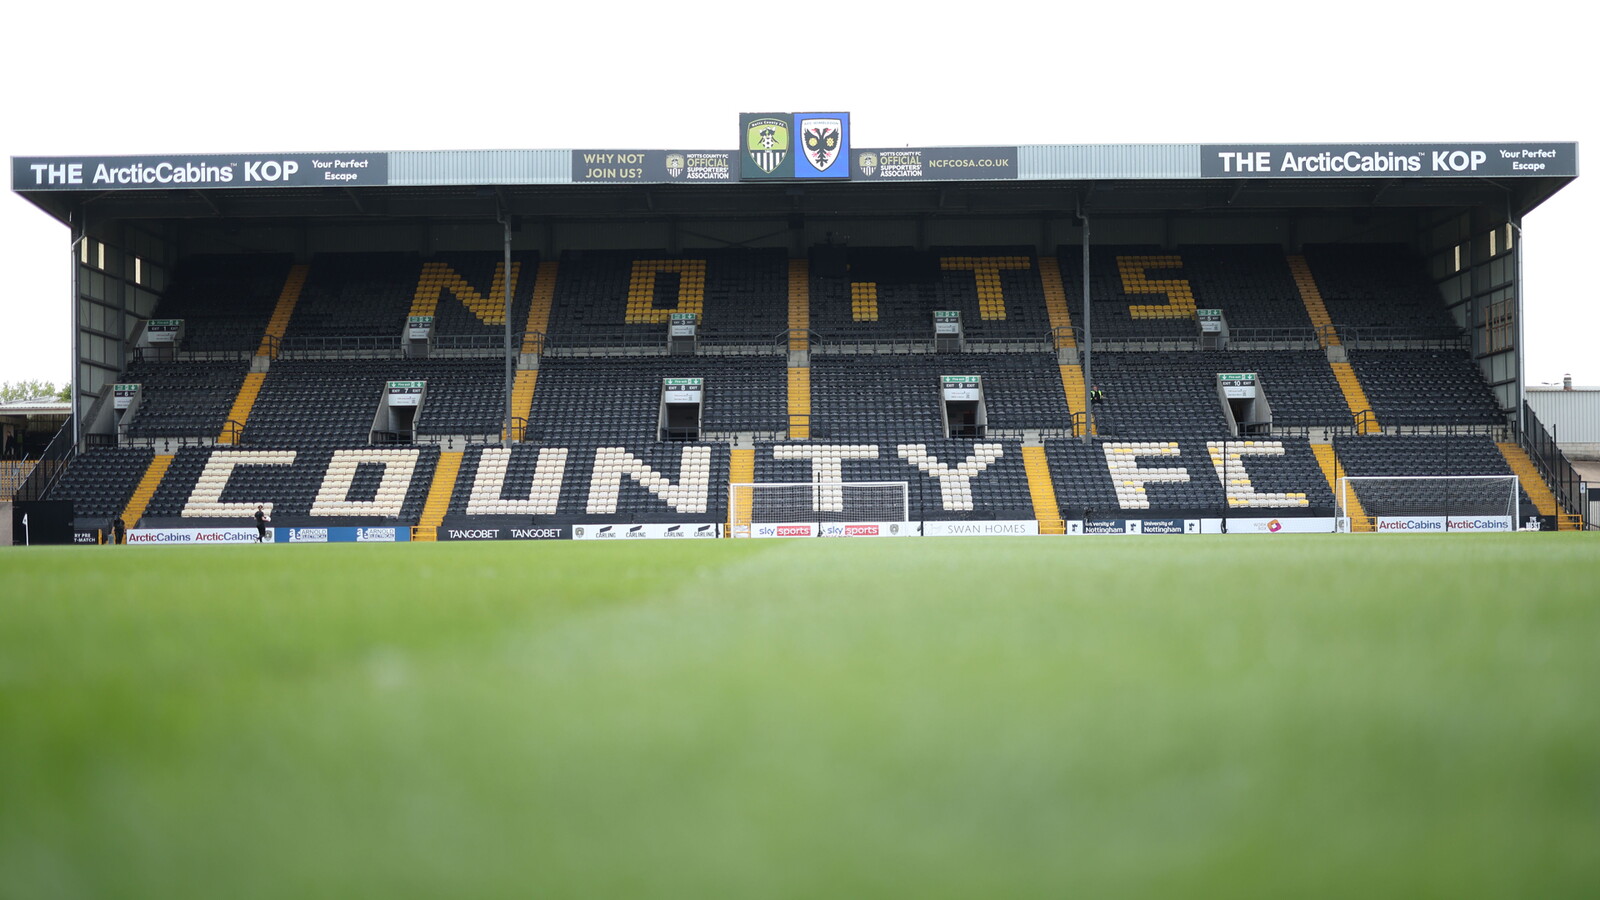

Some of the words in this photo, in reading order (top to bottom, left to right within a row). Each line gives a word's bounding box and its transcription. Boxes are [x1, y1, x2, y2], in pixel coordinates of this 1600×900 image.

[584, 154, 614, 164] WHY
[617, 154, 645, 164] NOT
[1500, 150, 1520, 159] Your
[1522, 149, 1556, 158] Perfect
[312, 160, 333, 169] Your
[335, 159, 368, 169] Perfect
[687, 158, 728, 166] OFFICIAL
[880, 156, 922, 164] OFFICIAL
[929, 159, 1009, 168] NCFCOSA.CO.UK
[1219, 152, 1270, 172] THE
[1432, 150, 1487, 171] KOP
[1512, 161, 1546, 171] Escape
[31, 164, 83, 184] THE
[244, 160, 299, 182] KOP
[324, 172, 357, 182] Escape
[586, 168, 616, 178] JOIN
[620, 168, 643, 178] US?
[828, 526, 843, 534] sky
[845, 525, 878, 535] sports
[948, 525, 980, 534] SWAN
[985, 524, 1026, 533] HOMES
[1379, 521, 1442, 530] ArcticCabins
[1448, 520, 1508, 530] ArcticCabins
[448, 530, 499, 538] TANGOBET
[511, 529, 562, 538] TANGOBET
[760, 527, 775, 536] sky
[777, 526, 810, 536] sports
[129, 533, 190, 542] ArcticCabins
[196, 532, 258, 540] ArcticCabins
